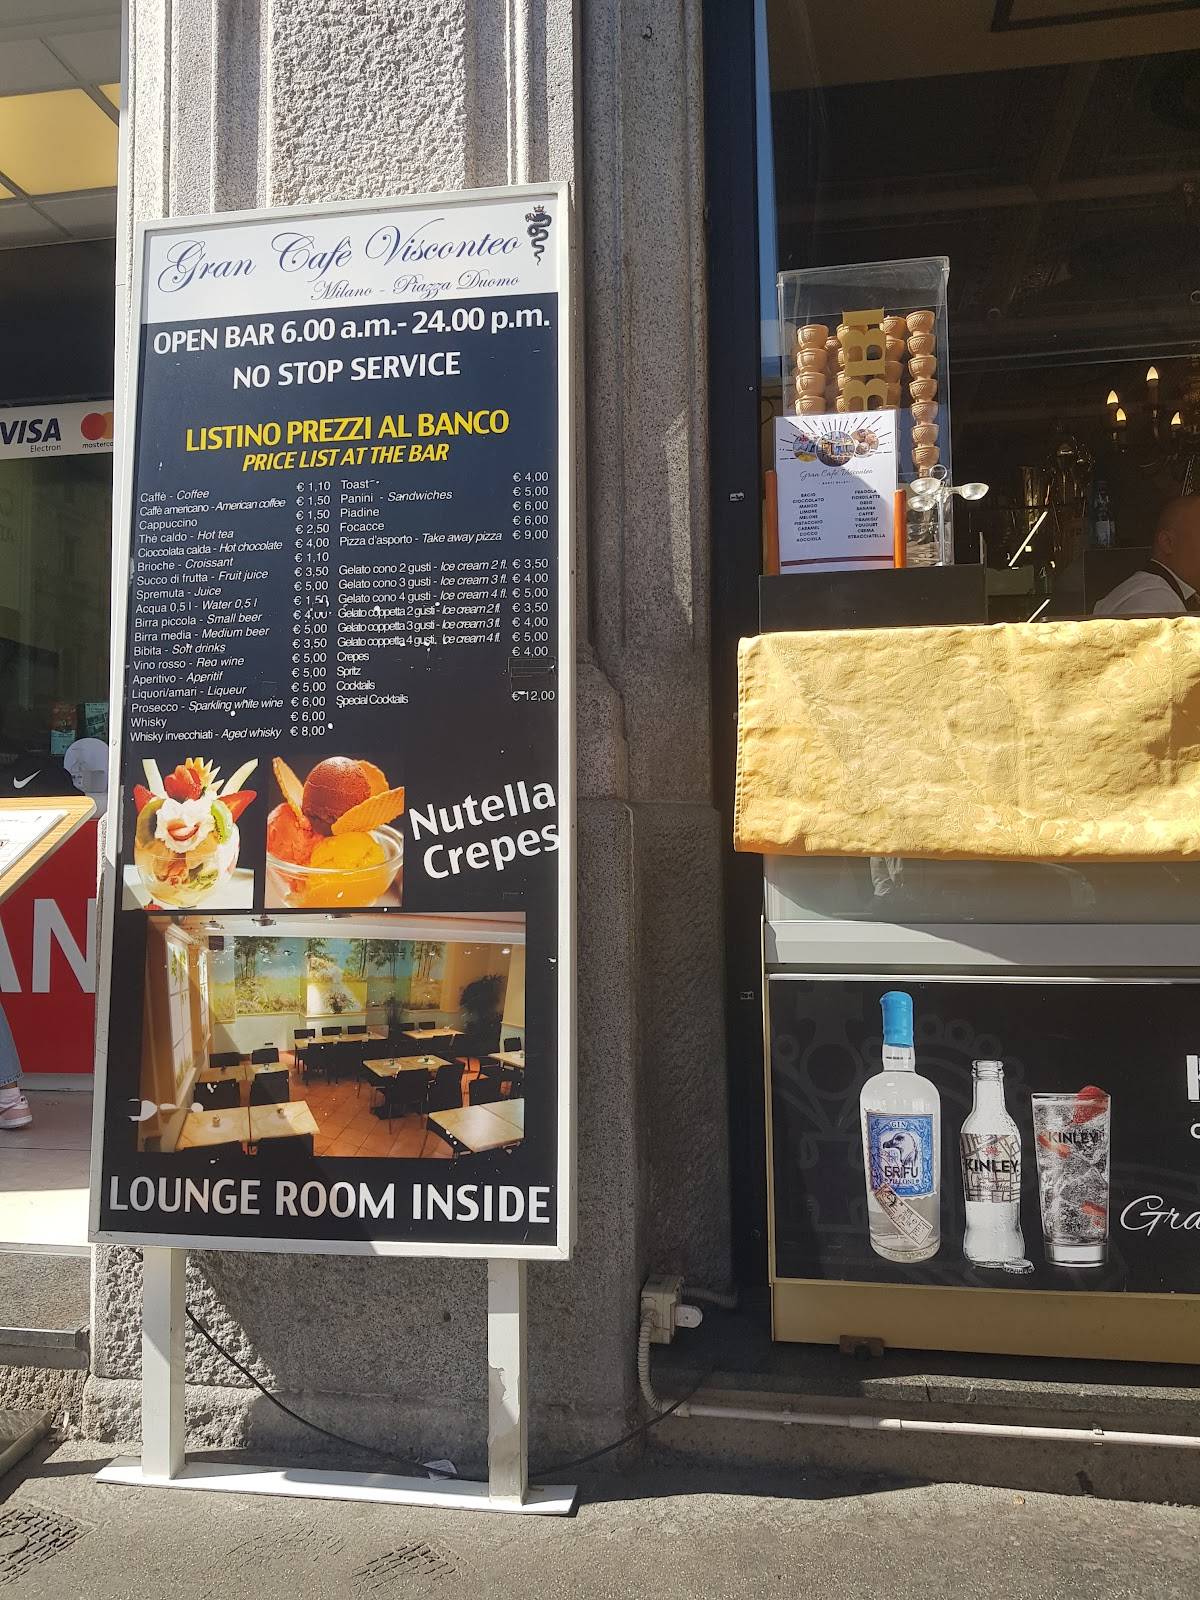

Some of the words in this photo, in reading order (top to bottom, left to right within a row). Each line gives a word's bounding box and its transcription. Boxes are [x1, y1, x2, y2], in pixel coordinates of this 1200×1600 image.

[157, 239, 257, 293] Gran
[365, 217, 521, 267] Visconteo
[310, 279, 374, 301] Milano
[391, 273, 451, 300] Piazza
[455, 270, 520, 290] Duomo
[154, 328, 218, 354] OPEN
[225, 323, 274, 348] BAR
[281, 318, 335, 343] 6.00
[412, 307, 485, 334] 24.00
[491, 309, 551, 334] p.m.
[234, 365, 270, 389] NO
[278, 360, 343, 385] STOP
[351, 352, 460, 380] SERVICE
[0, 418, 61, 445] VISA
[187, 423, 281, 451] LISTINO
[287, 417, 371, 444] PREZZI
[378, 415, 412, 438] AL
[418, 410, 509, 436] BANCO
[30, 444, 61, 453] Electron
[242, 452, 296, 471] PRICE
[299, 449, 340, 468] LIST
[340, 447, 368, 465] AT
[371, 445, 406, 464] THE
[408, 444, 449, 462] BAR
[341, 480, 369, 489] Toast
[525, 472, 548, 482] 4,00
[177, 489, 209, 500] Coffee
[309, 481, 330, 492] 1,10
[341, 493, 373, 503] Panini
[388, 490, 452, 501] Sandwiches
[525, 486, 548, 497] 5,00
[164, 504, 209, 514] americano
[259, 498, 286, 508] coffee
[308, 495, 330, 506] 1,50
[340, 507, 379, 517] Piadine
[525, 500, 548, 511] 6,00
[139, 518, 197, 531] Cappuccino
[308, 509, 330, 520] 1,50
[340, 522, 384, 532] Focacce
[525, 515, 548, 526] 6,00
[160, 532, 187, 542] caldo
[197, 530, 216, 540] Hot
[218, 530, 234, 539] tea
[307, 524, 329, 535] 2,50
[340, 537, 366, 546] Pizza
[368, 535, 412, 546] d'asporto
[422, 533, 445, 543] Take
[447, 534, 474, 544] away
[475, 531, 502, 543] pizza
[525, 529, 548, 540] 9,00
[138, 547, 184, 558] Cioccolata
[186, 544, 211, 554] calda
[219, 543, 236, 552] Hot
[238, 541, 282, 551] chocolate
[306, 538, 329, 549] 4,00
[138, 561, 175, 571] Brioche
[185, 557, 233, 569] Croissant
[307, 552, 329, 563] 1,10
[339, 565, 371, 575] Gelato
[373, 565, 397, 573] cono
[408, 562, 431, 575] gusti
[440, 562, 455, 571] Ice
[457, 562, 489, 571] cream
[524, 558, 548, 569] 3,50
[137, 576, 167, 586] Succo
[170, 574, 179, 584] di
[182, 573, 208, 583] frutta
[218, 570, 242, 581] Fruit
[243, 570, 268, 582] juice
[306, 566, 328, 577] 3,50
[136, 589, 184, 601] Spremuta
[194, 586, 221, 596] Juice
[305, 581, 328, 592] 5,00
[136, 604, 167, 615] Acqua
[170, 602, 185, 613] 0,5
[203, 600, 233, 610] Water
[235, 598, 251, 609] 0,5
[135, 618, 158, 627] Birra
[161, 616, 196, 628] piccola
[207, 613, 236, 624] Small
[238, 613, 262, 622] beer
[135, 632, 158, 642] Birra
[161, 630, 191, 640] media
[202, 628, 243, 638] Medium
[246, 627, 270, 636] beer
[304, 624, 327, 635] 5,00
[134, 646, 161, 656] Bibita
[172, 643, 193, 654] Soft
[195, 643, 226, 653] drinks
[304, 638, 327, 649] 3,50
[337, 652, 369, 663] Crepes
[524, 646, 548, 658] 4,00
[133, 661, 155, 670] Vino
[158, 661, 186, 669] rosso
[221, 656, 244, 666] wine
[304, 653, 327, 664] 5,00
[133, 674, 176, 686] Aperitivo
[186, 671, 223, 684] Aperitif
[303, 667, 326, 678] 5,00
[337, 666, 361, 678] Spritz
[132, 686, 197, 700] Liquori/amari
[207, 686, 247, 697] Liqueur
[303, 682, 326, 693] 5,00
[336, 680, 375, 691] Cocktails
[132, 703, 178, 713] Prosecco
[189, 700, 232, 713] Sparkling
[234, 699, 259, 709] white
[261, 698, 283, 708] wine
[302, 696, 325, 708] 6,00
[336, 695, 368, 707] Special
[369, 694, 408, 704] Cocktails
[523, 691, 555, 701] 12,00
[131, 717, 167, 728] Whisky
[302, 711, 325, 722] 6,00
[130, 732, 163, 743] Whisky
[165, 730, 213, 740] invecchiati
[221, 728, 248, 741] Aged
[249, 727, 282, 739] whisky
[302, 726, 325, 737] 8,00
[408, 780, 556, 841] Nutella
[422, 823, 560, 880] Crepes
[110, 1176, 260, 1214] LOUNGE
[276, 1181, 394, 1219] ROOM
[413, 1184, 550, 1223] INSIDE
